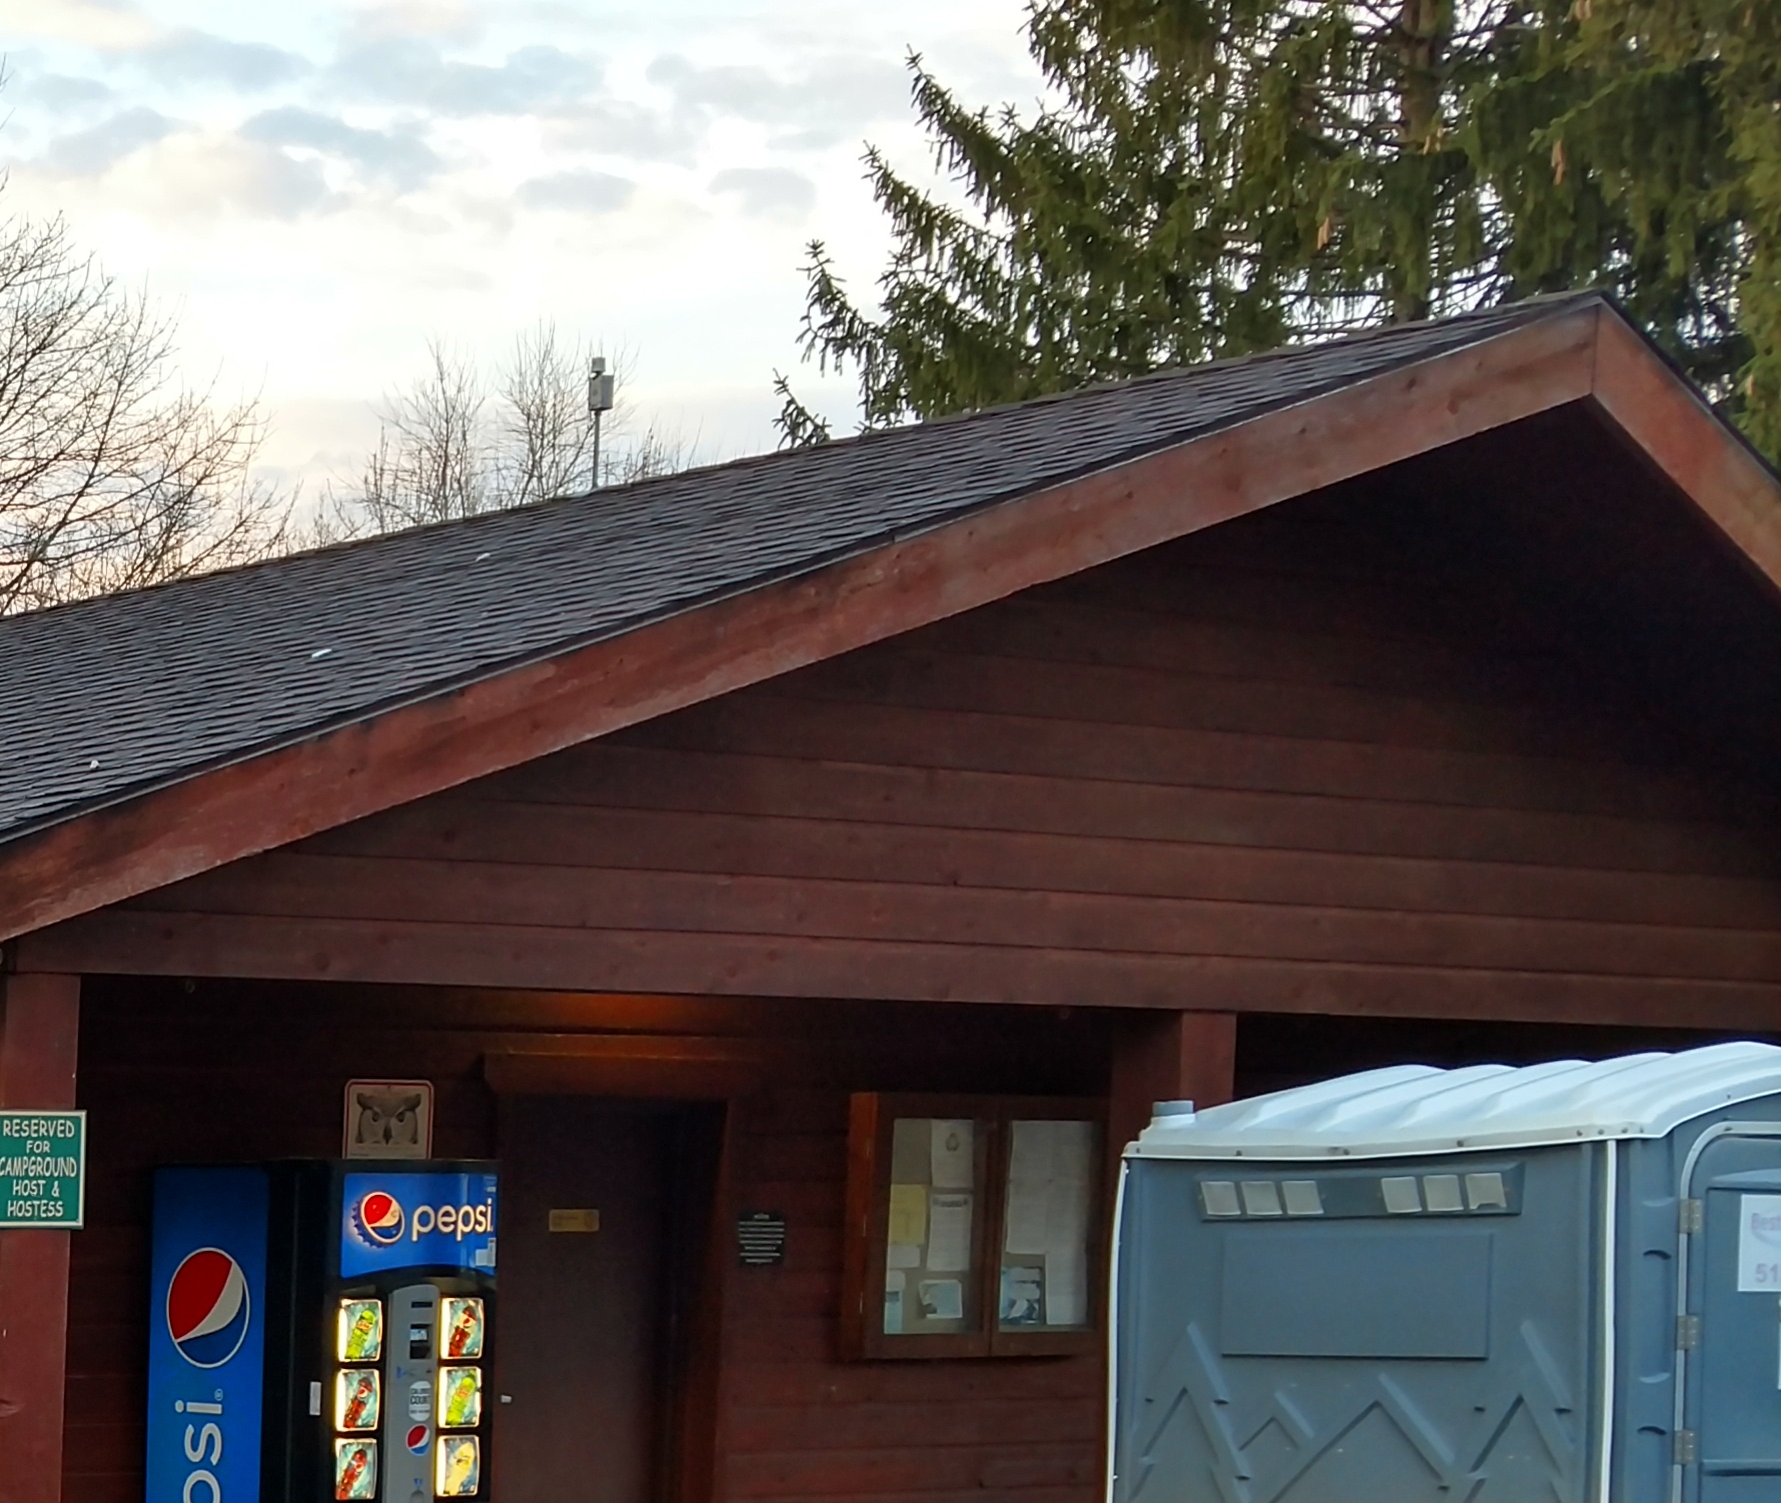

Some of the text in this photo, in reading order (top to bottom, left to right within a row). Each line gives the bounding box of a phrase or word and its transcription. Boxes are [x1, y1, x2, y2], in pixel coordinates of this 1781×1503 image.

[2, 1118, 75, 1138] RESERVED
[26, 1140, 51, 1154] FOR
[12, 1179, 60, 1197] HOST &
[7, 1199, 64, 1218] HOSTESS
[411, 1197, 493, 1242] pepsi
